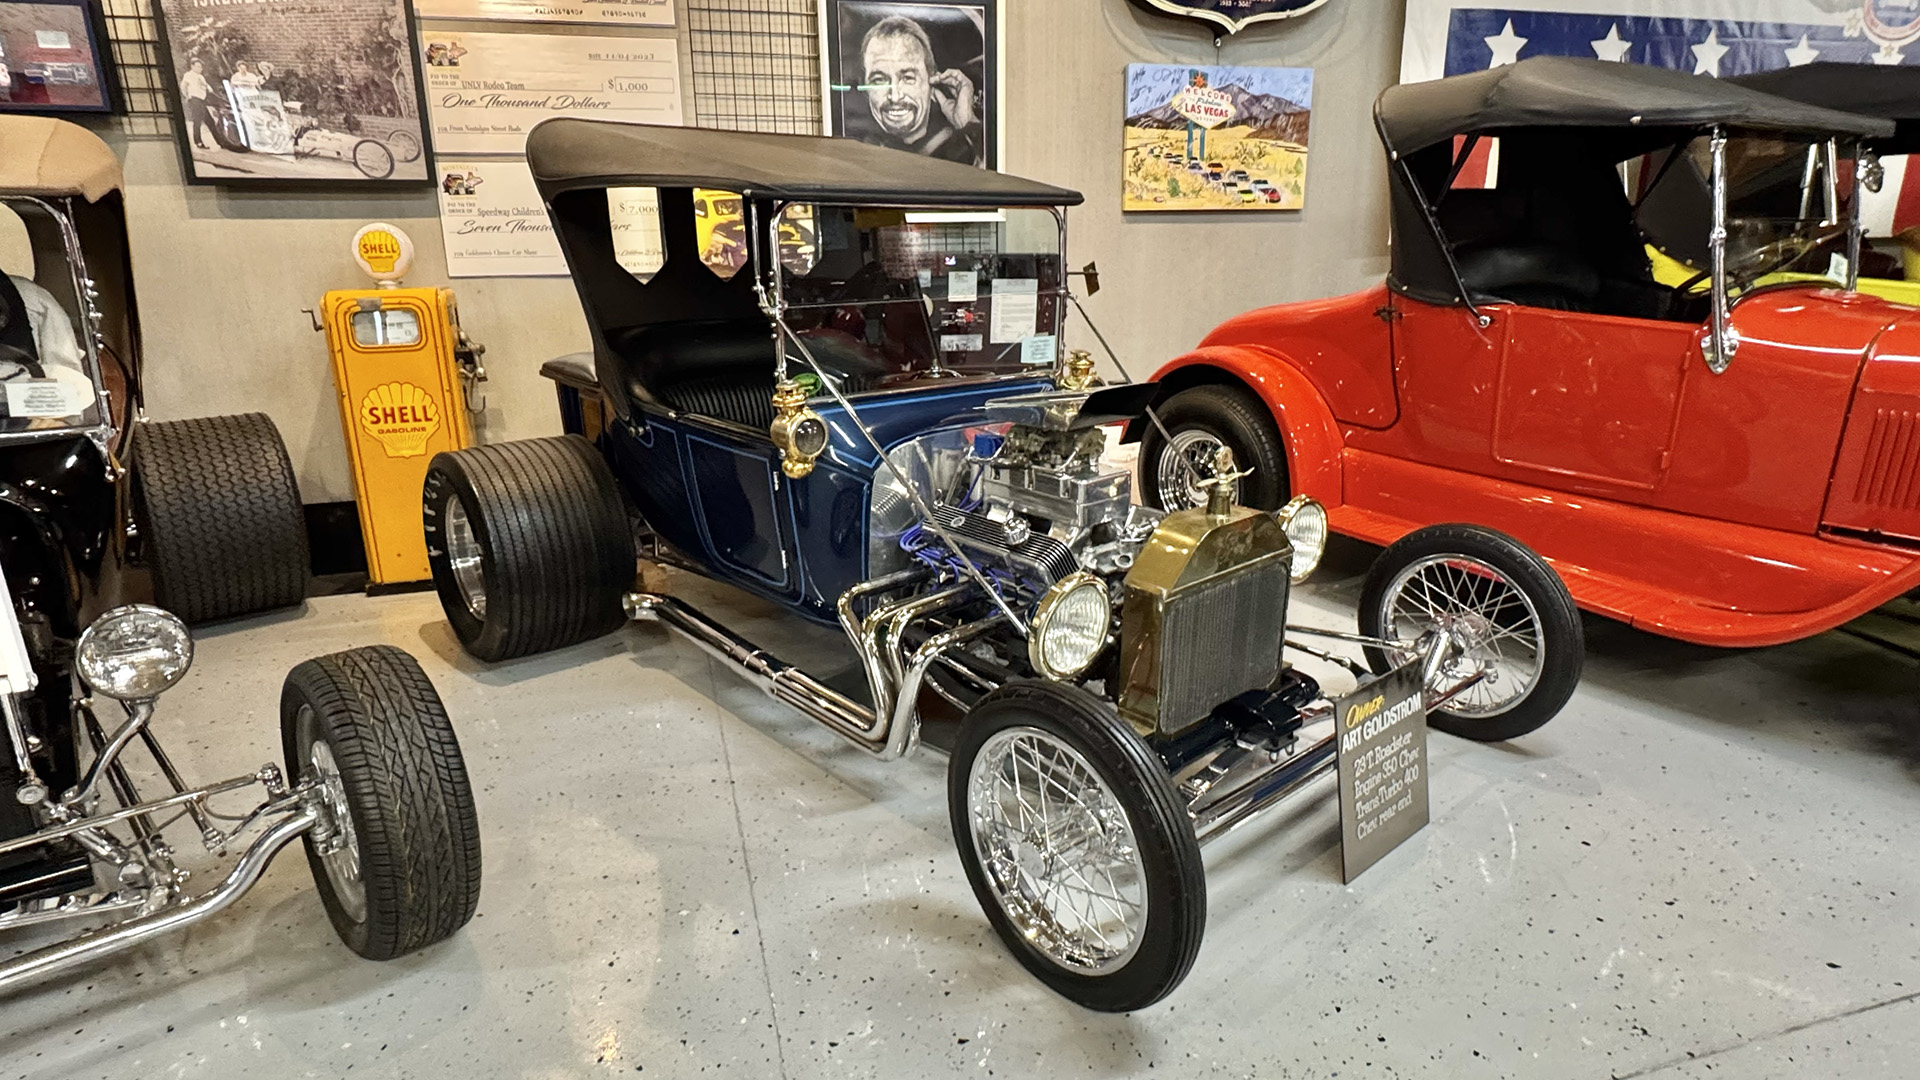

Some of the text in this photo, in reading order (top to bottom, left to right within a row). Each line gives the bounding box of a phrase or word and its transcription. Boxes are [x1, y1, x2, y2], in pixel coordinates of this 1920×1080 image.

[483, 80, 504, 90] Rodeo
[506, 81, 525, 90] Team
[607, 78, 648, 92] $ 1,000
[442, 92, 612, 110] One Thousand Dollars
[1184, 87, 1231, 102] WELCOME
[1185, 103, 1229, 118] LAS VEGAS
[477, 207, 510, 217] Speedway
[456, 219, 502, 235] Seven
[362, 243, 397, 254] SHELL
[368, 405, 433, 424] SHELL
[377, 426, 427, 435] GASOLINE
[1341, 691, 1422, 755] ART GOLDSTROM
[1374, 732, 1412, 765] Roadster
[1354, 772, 1381, 799] Engine
[1382, 756, 1398, 779] 350
[1404, 764, 1419, 785] 400
[1379, 804, 1397, 826] rear
[1398, 789, 1412, 811] end
